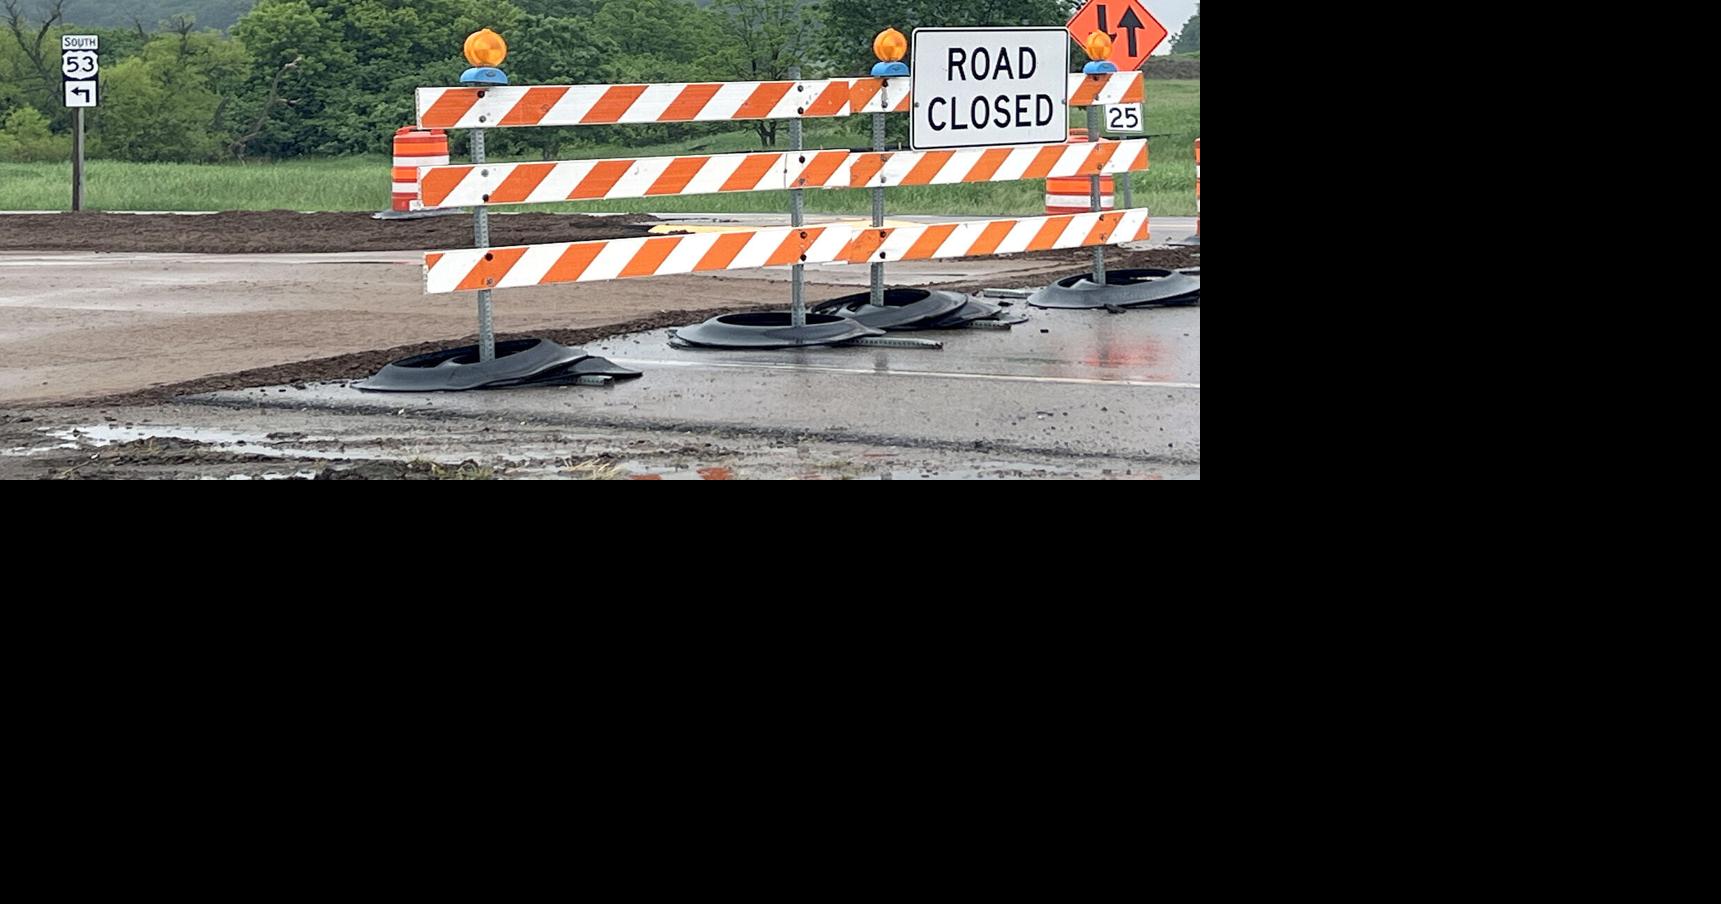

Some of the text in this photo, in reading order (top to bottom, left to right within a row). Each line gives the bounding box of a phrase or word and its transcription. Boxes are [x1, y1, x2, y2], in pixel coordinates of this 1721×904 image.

[64, 37, 96, 47] SOUTH
[67, 56, 94, 73] 53
[948, 46, 1037, 81] ROAD
[928, 94, 1053, 131] CLOSED
[1109, 107, 1138, 128] 25
